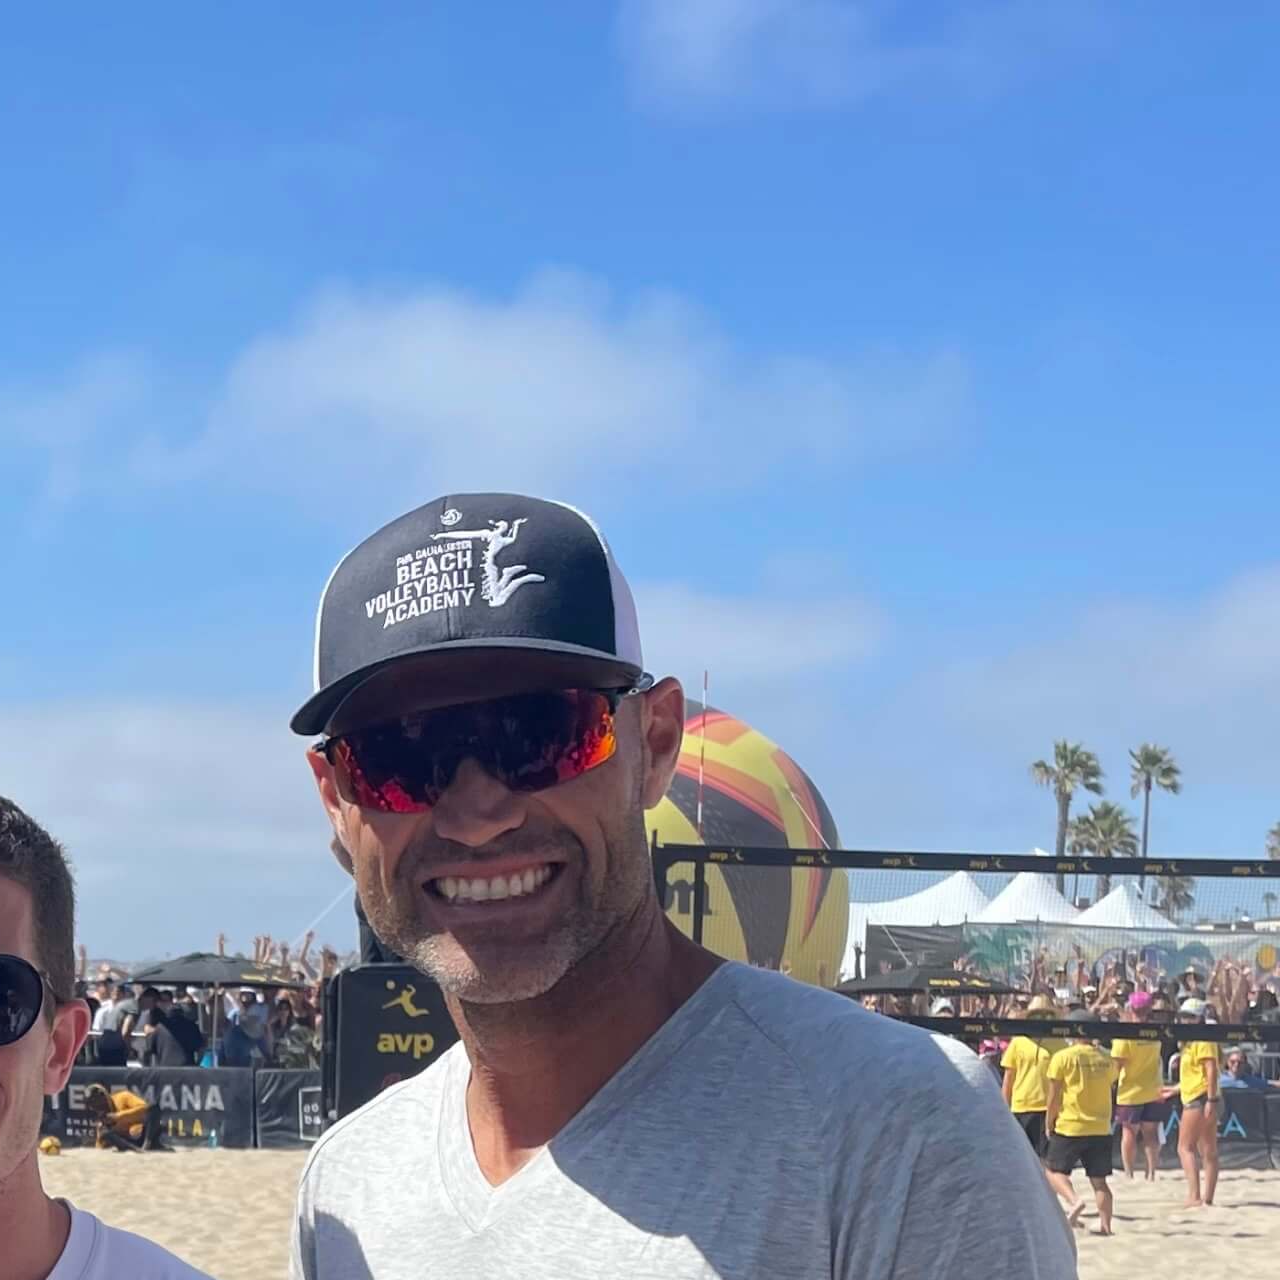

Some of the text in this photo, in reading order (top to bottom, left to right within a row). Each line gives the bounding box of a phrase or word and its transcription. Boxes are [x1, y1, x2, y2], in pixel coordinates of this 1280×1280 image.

[397, 550, 473, 586] BEACH
[365, 569, 475, 618] VOLLEYBALL
[382, 588, 476, 629] ACADEMY
[377, 1032, 435, 1060] avp
